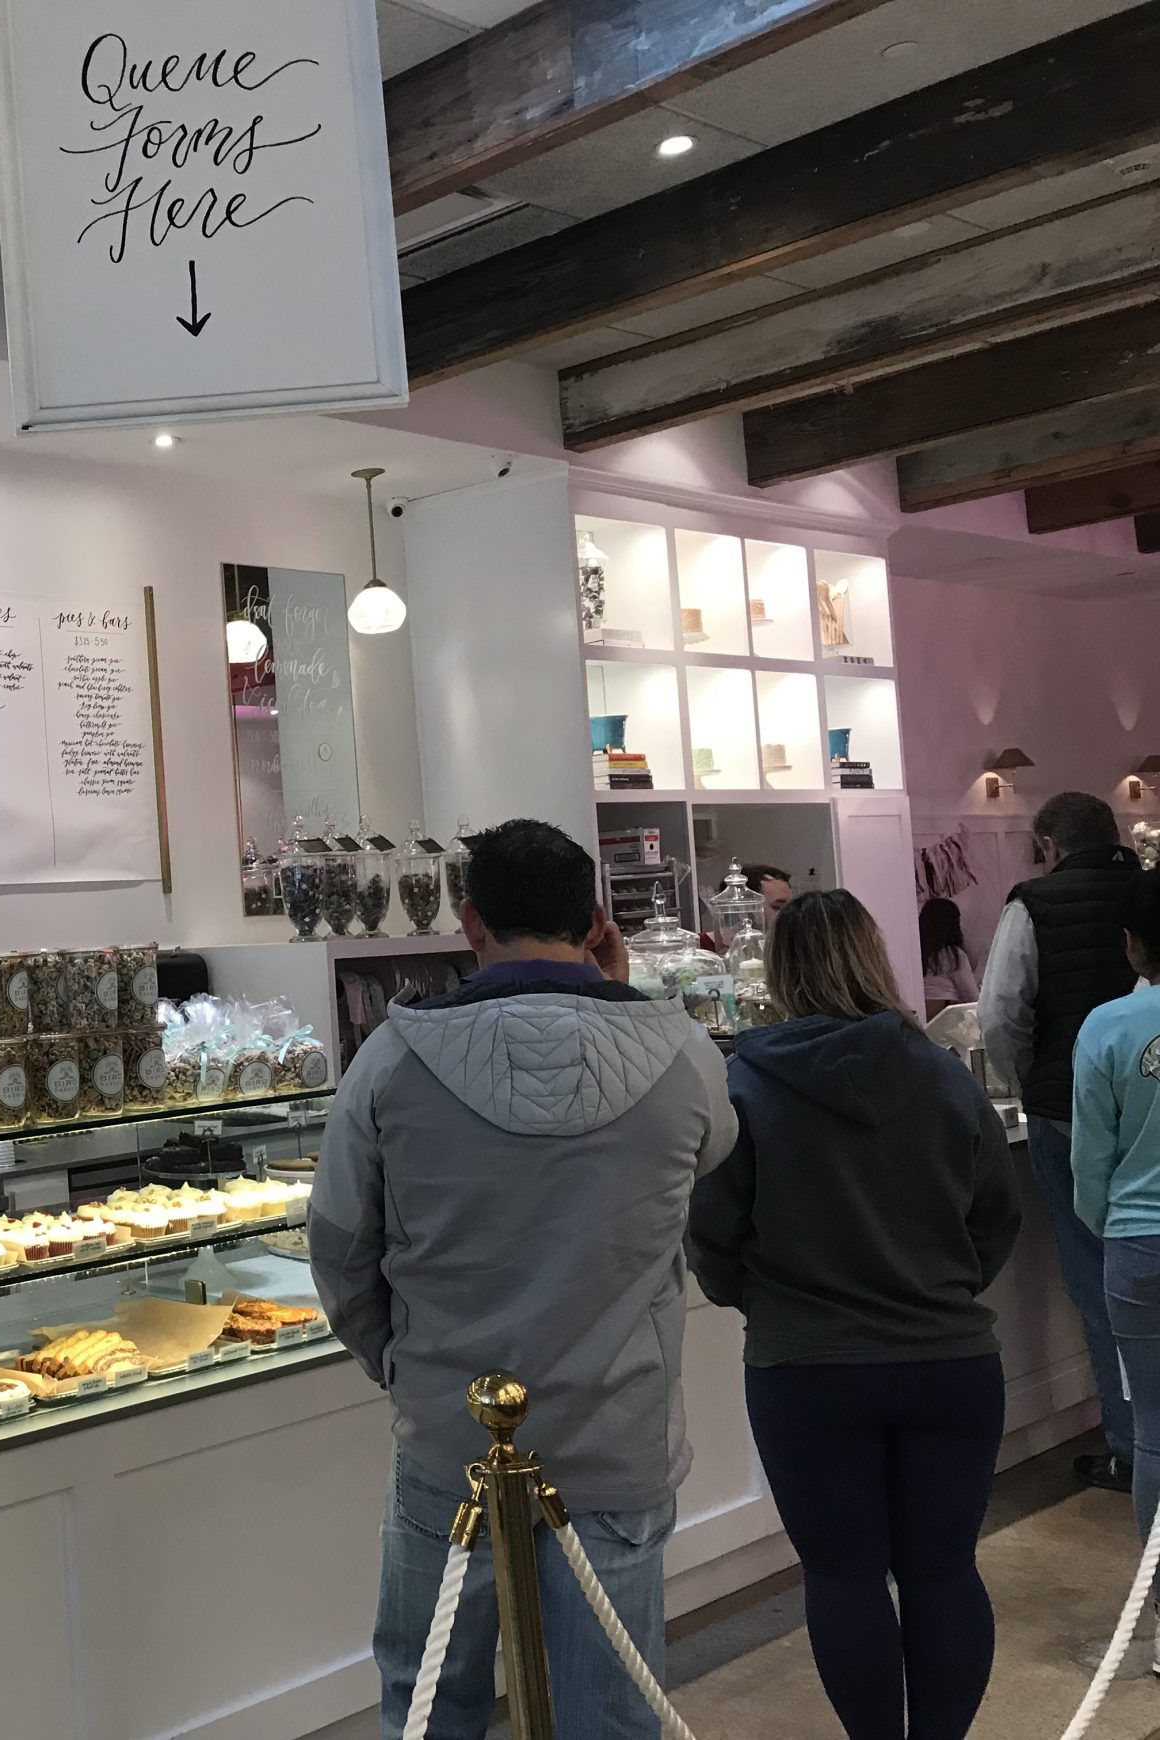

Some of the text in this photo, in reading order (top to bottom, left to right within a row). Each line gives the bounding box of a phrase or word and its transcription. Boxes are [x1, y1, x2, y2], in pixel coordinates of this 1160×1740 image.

[81, 33, 320, 112] Queue
[59, 104, 322, 193] Forms
[77, 176, 314, 264] Here
[51, 612, 84, 629] pies
[100, 610, 133, 630] bars
